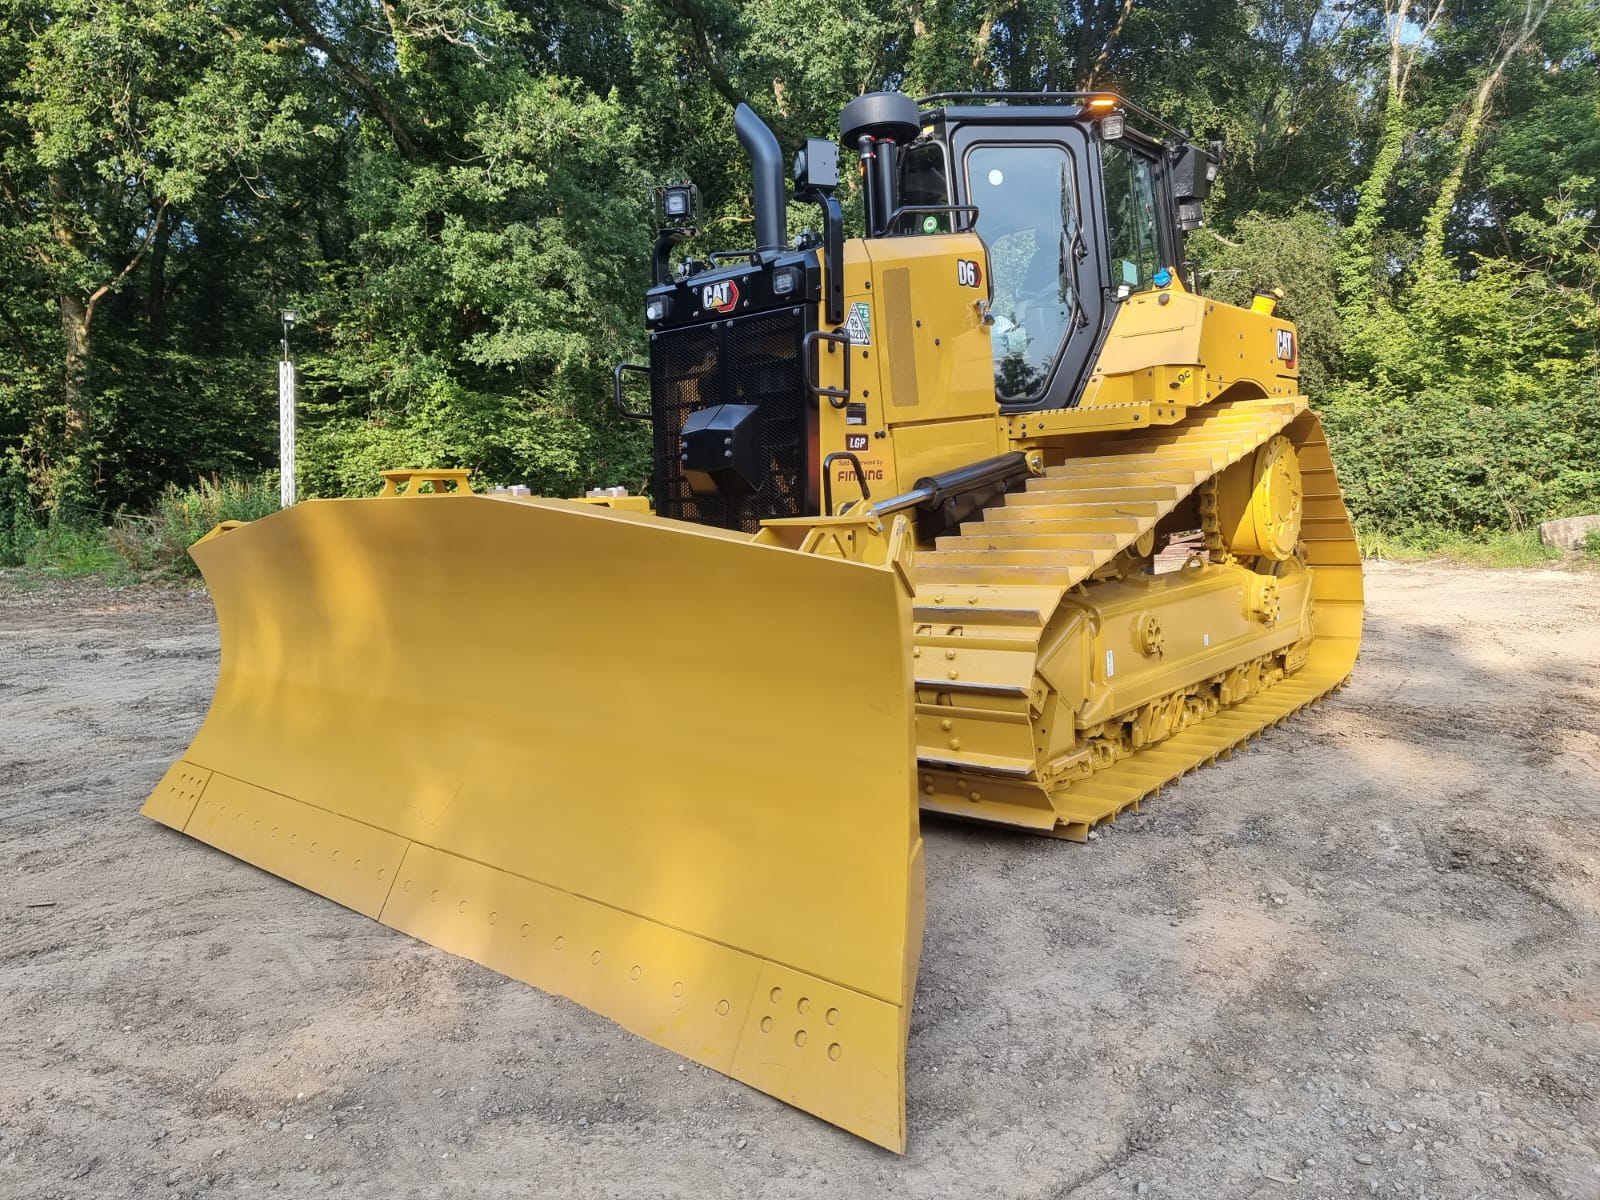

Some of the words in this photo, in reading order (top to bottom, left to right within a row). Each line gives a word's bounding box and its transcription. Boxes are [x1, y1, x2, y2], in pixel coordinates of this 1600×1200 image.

[958, 260, 975, 287] D6
[703, 282, 730, 309] CAT
[1277, 329, 1292, 360] CAT
[849, 437, 866, 449] LGP
[838, 469, 883, 482] FINING
